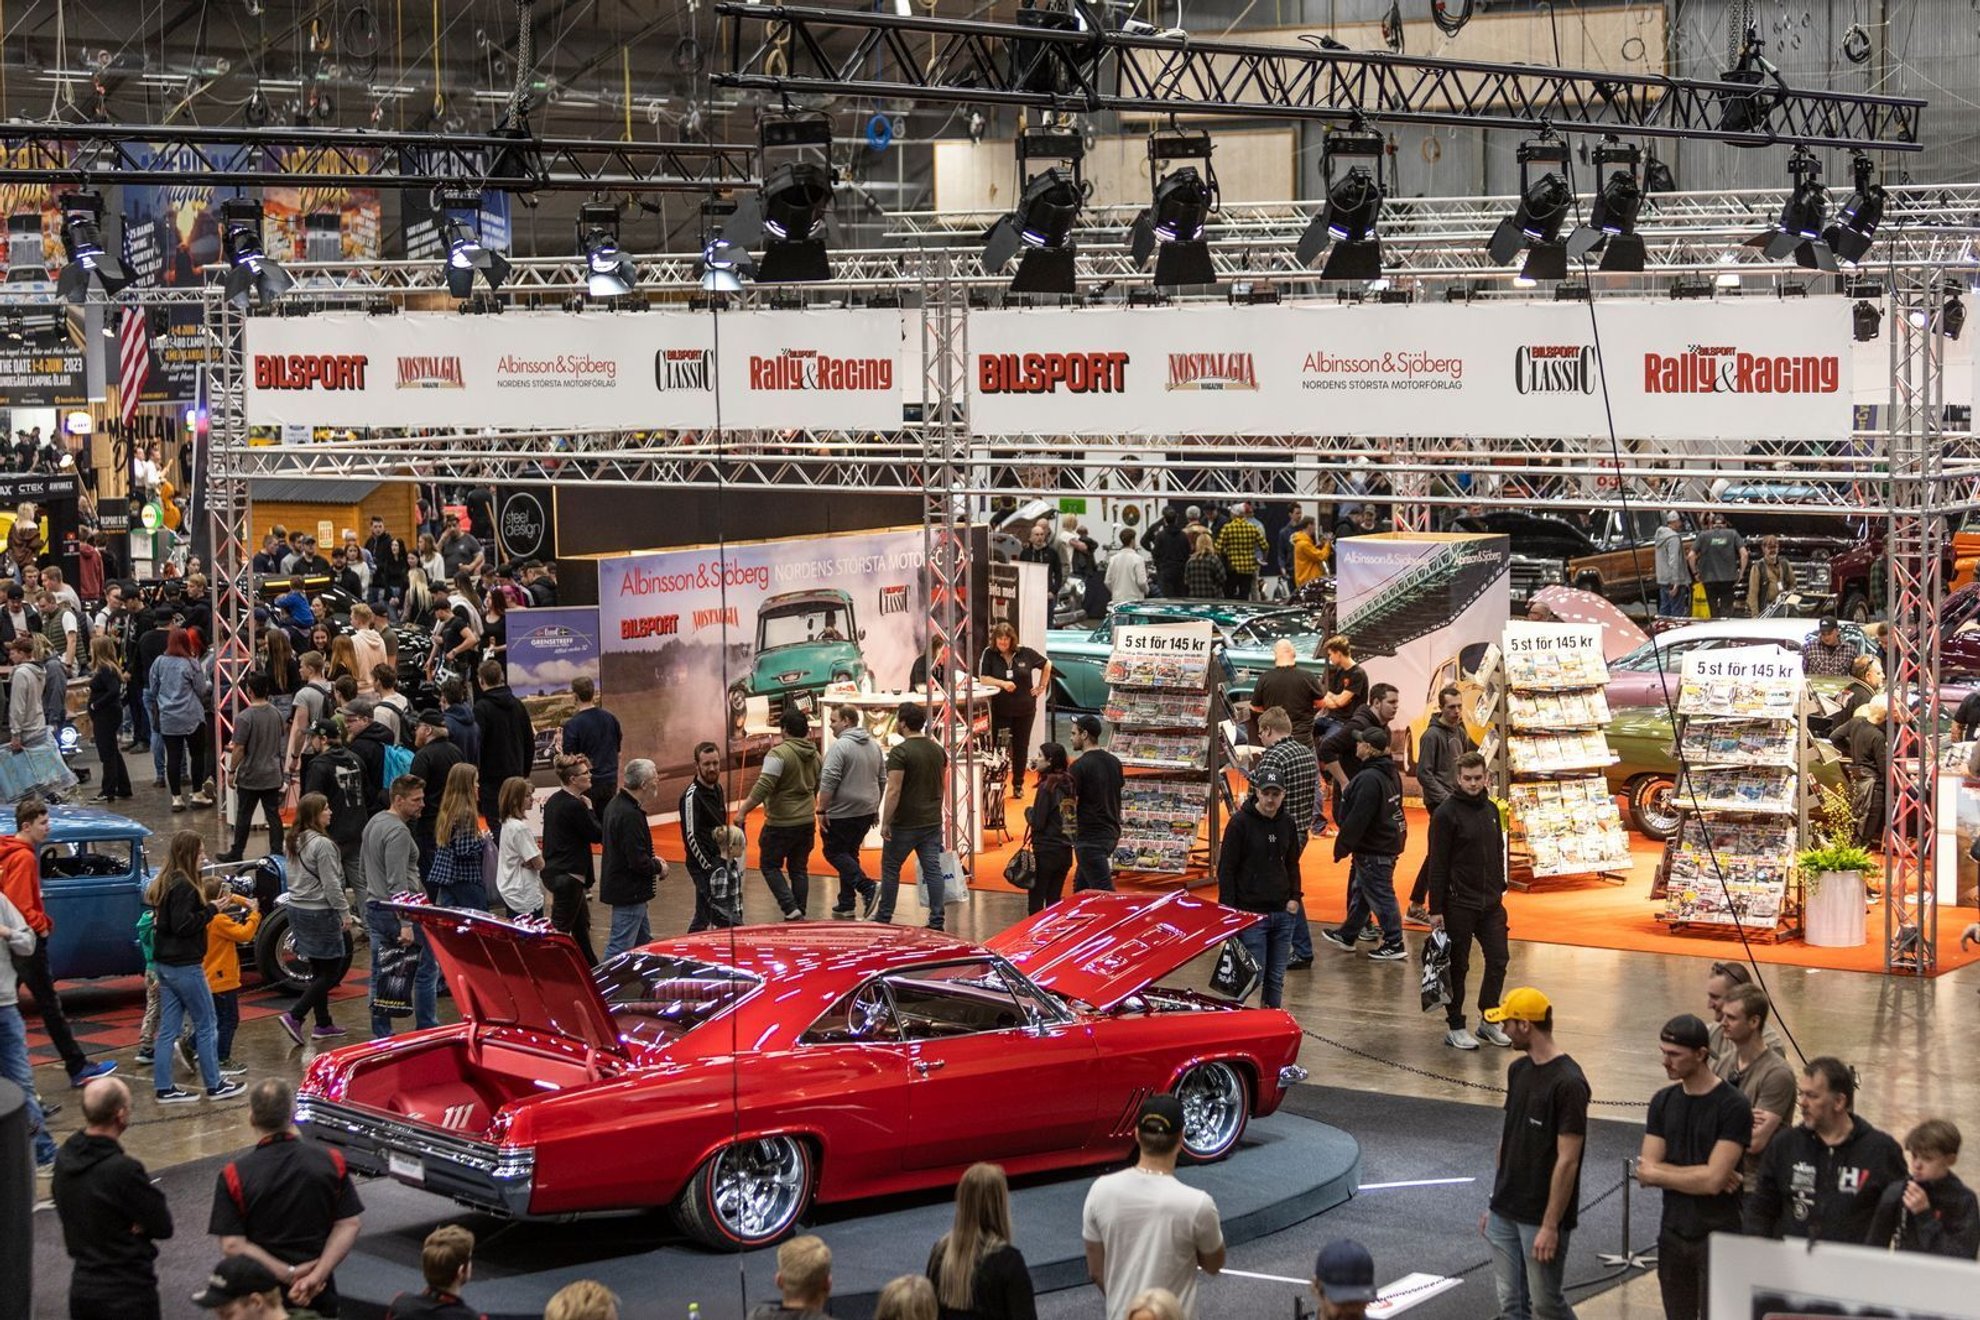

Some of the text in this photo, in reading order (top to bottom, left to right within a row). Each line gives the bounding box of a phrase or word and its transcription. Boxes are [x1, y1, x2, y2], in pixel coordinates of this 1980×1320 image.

[13, 358, 31, 373] DATE
[64, 357, 82, 373] 2023
[255, 355, 368, 390] BILSPORT
[397, 356, 463, 387] NOSTALGIA
[655, 349, 714, 392] CLASSIC
[979, 352, 1130, 394] BILSPORT
[1167, 353, 1257, 390] NOSTALGIA
[1515, 345, 1597, 395] CLASSIC
[497, 378, 616, 388] NORDENS STÖRSTA MOTORFÖRLAG
[1302, 379, 1462, 390] NORDENS STÖRSTA MOTORFÖRLAG
[18, 482, 44, 493] CTEK
[505, 509, 529, 526] steel
[505, 523, 541, 539] design
[774, 559, 833, 582] NORDENS
[836, 555, 887, 575] STÖRSTA
[621, 614, 679, 640] BILSPORT
[1125, 634, 1205, 651] 5 st för 145 kr
[1511, 635, 1593, 651] 5 st för 145 kr
[1697, 661, 1793, 678] 5 st för 145 kr
